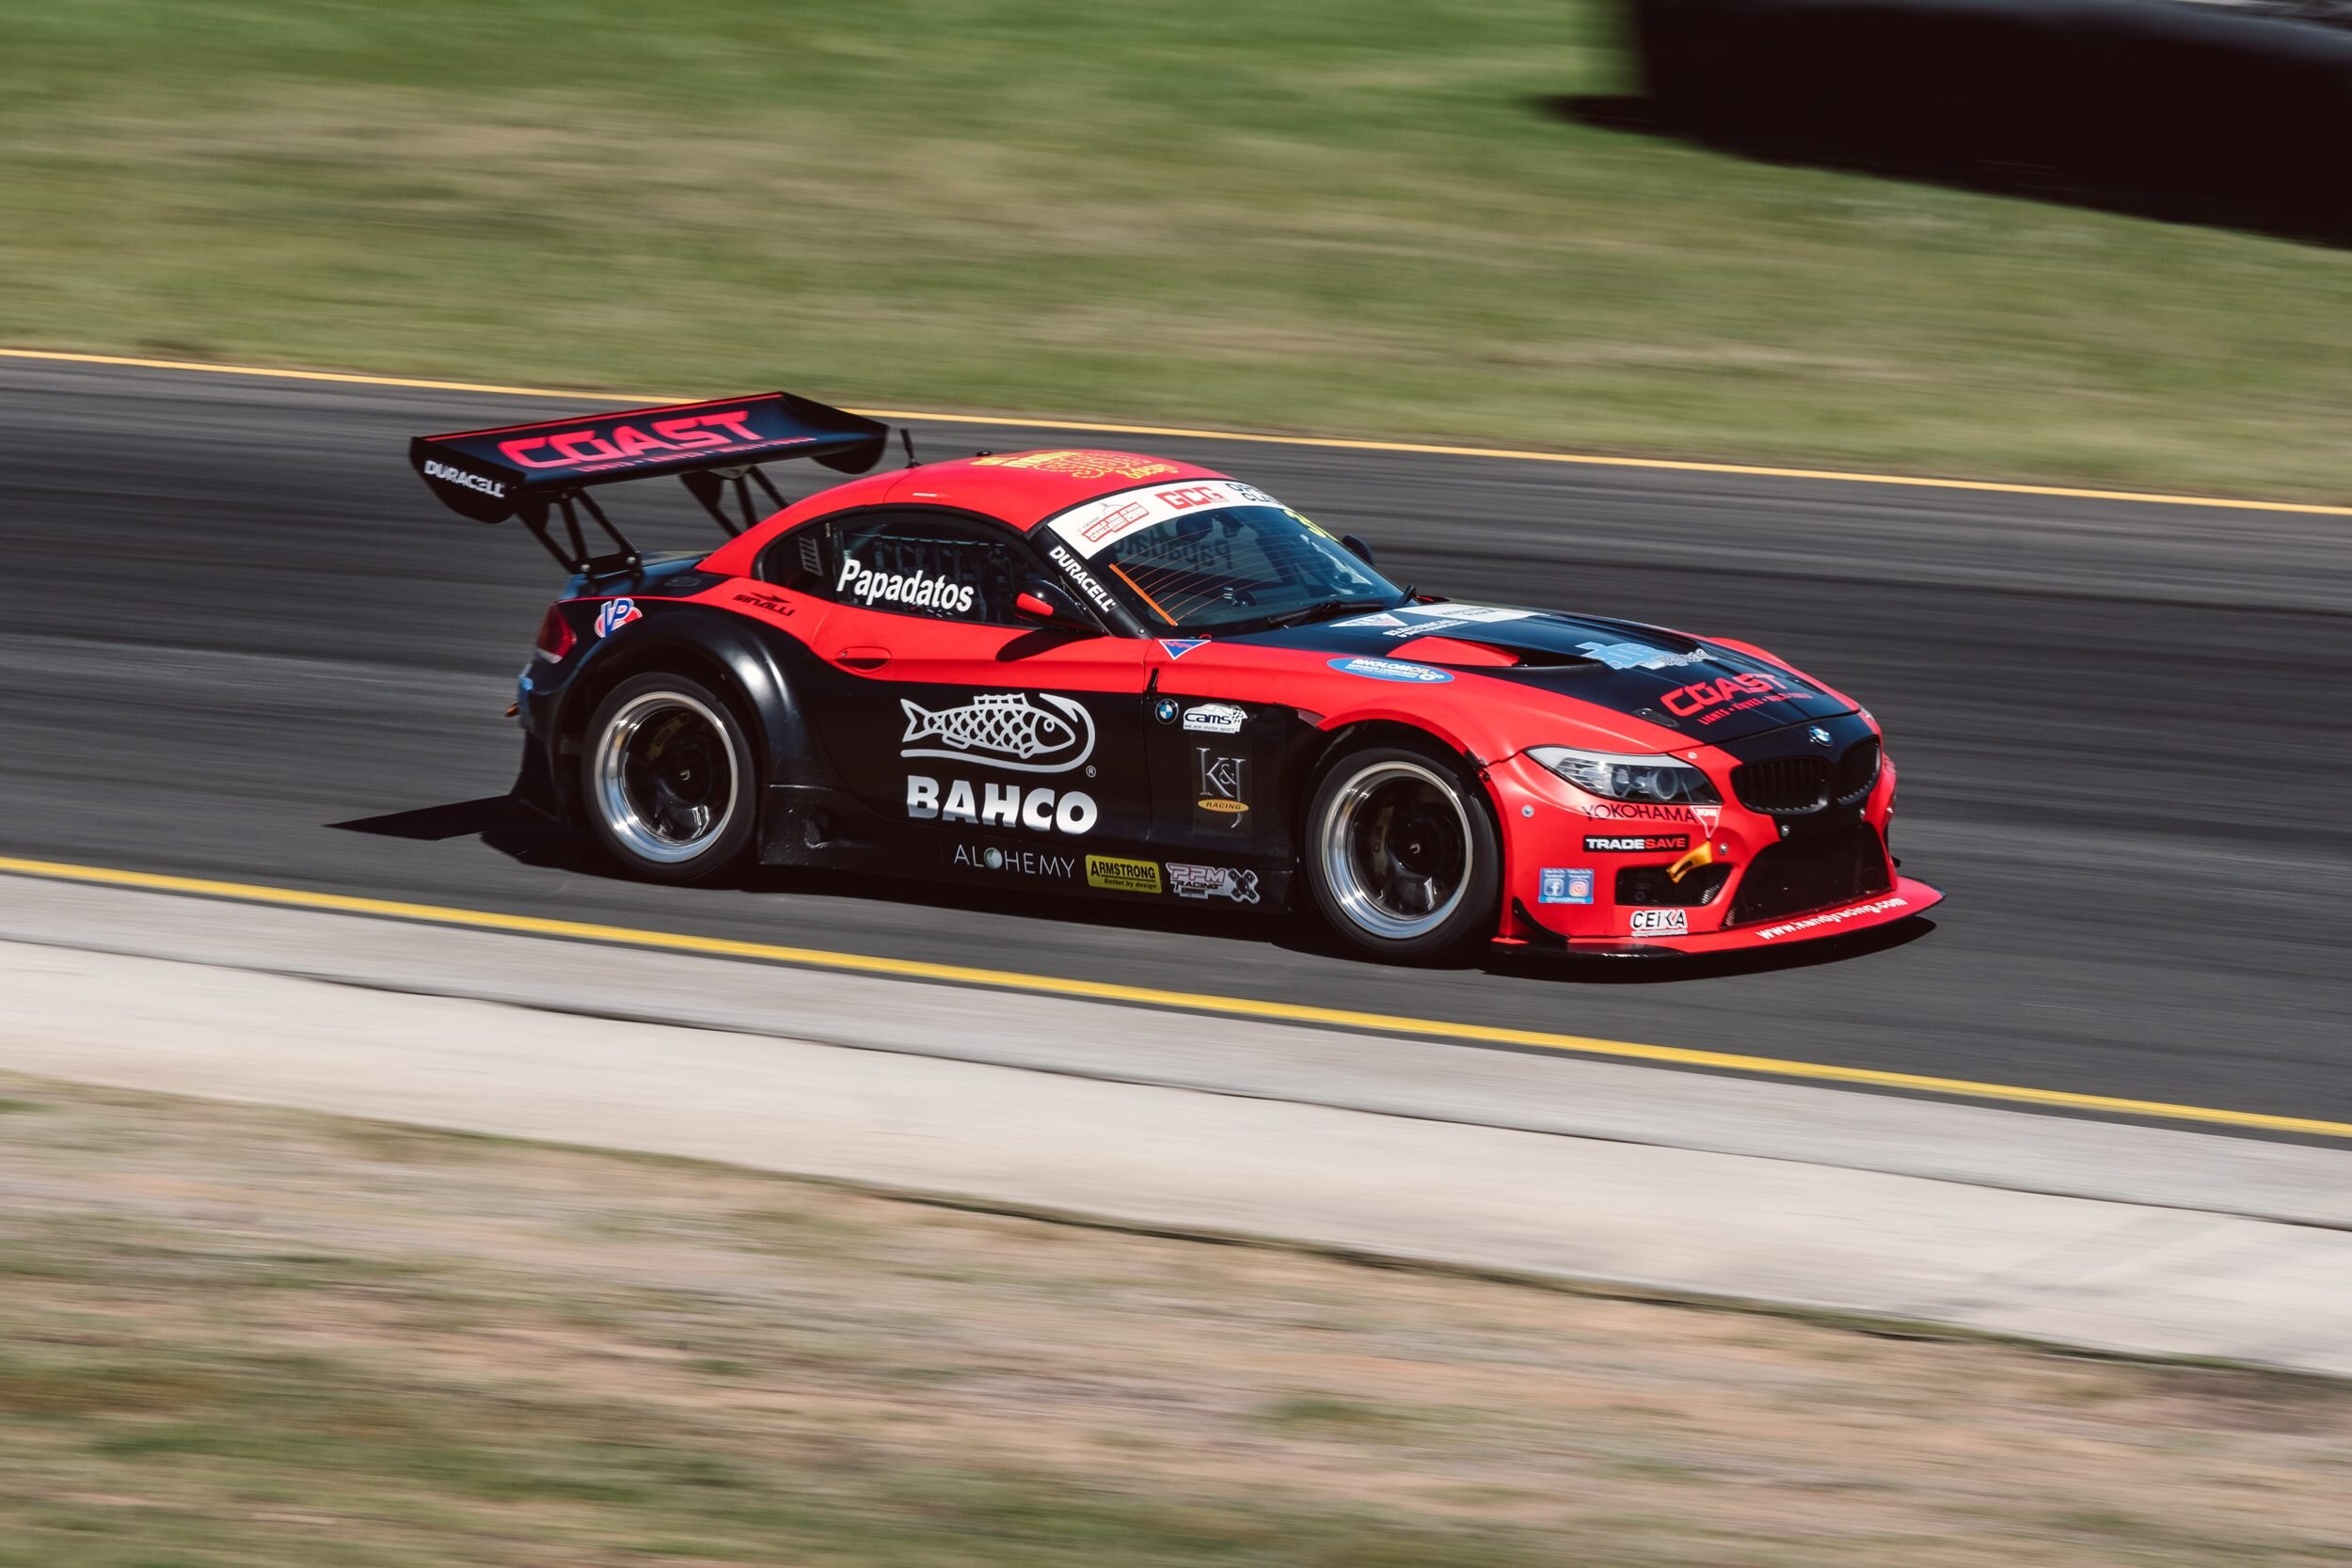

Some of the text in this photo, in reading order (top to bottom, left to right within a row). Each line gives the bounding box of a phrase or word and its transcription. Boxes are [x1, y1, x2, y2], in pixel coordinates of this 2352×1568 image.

[497, 411, 765, 469] COAST
[423, 460, 505, 499] DURACELL
[1154, 486, 1226, 510] GCG
[836, 559, 974, 612] Papadatos
[1049, 546, 1114, 612] DURACELL
[1660, 673, 1788, 717] COAST
[1184, 713, 1232, 725] cams
[906, 775, 1098, 834] BAHCO
[1205, 801, 1242, 810] RACING
[1581, 804, 1699, 824] YOKOHAMA
[1585, 837, 1687, 849] TRADESAVE
[1090, 861, 1156, 879] ARMSTRONG
[1169, 865, 1225, 884] PPM
[1136, 881, 1157, 890] design
[1172, 880, 1223, 891] RACING
